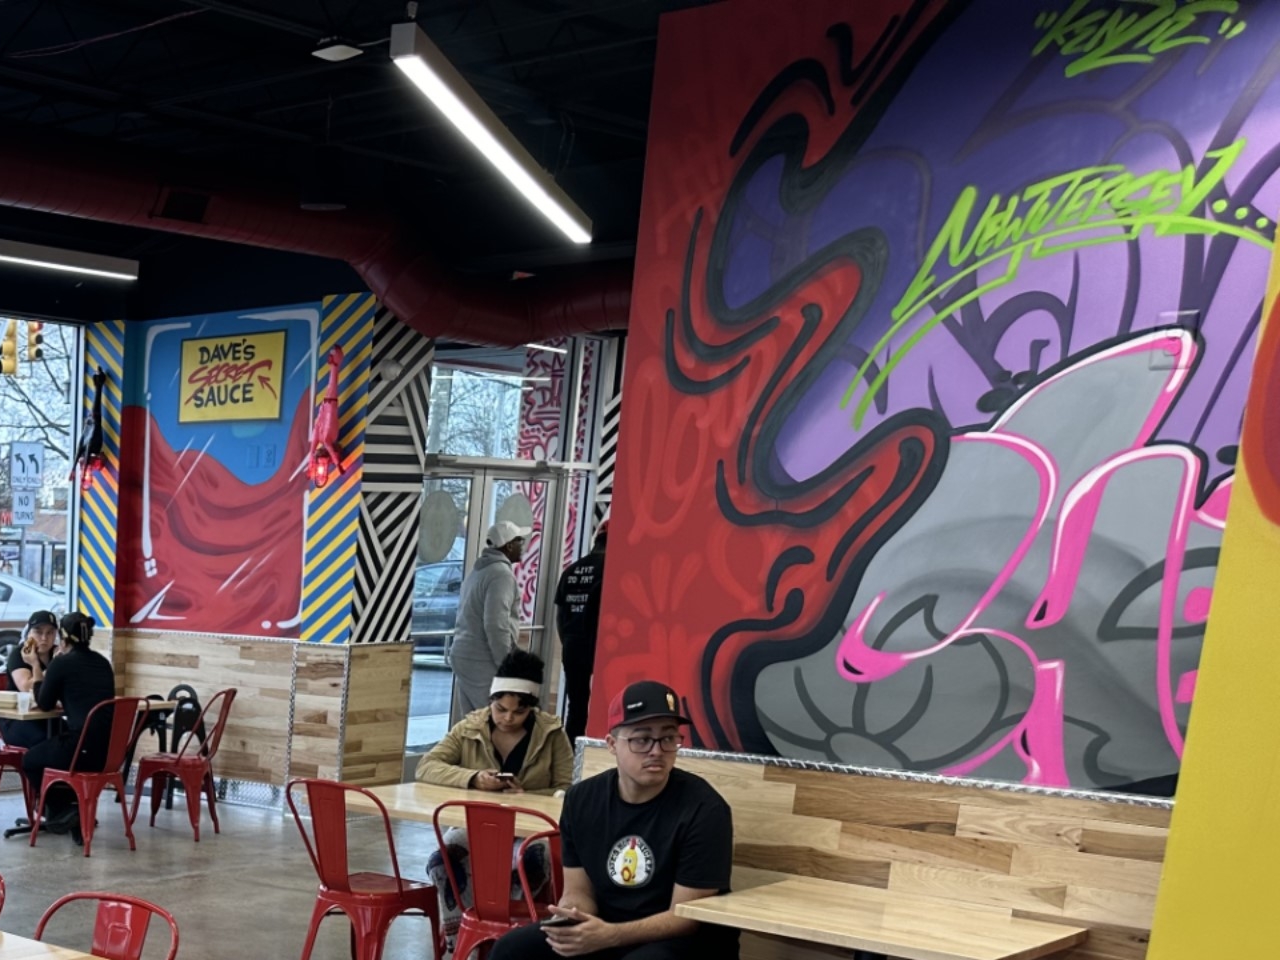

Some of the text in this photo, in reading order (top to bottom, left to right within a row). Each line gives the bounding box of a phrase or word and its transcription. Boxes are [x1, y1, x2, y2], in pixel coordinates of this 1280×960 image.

[199, 338, 256, 365] DAVE'S
[193, 384, 254, 408] SAUCE
[18, 495, 29, 507] NO
[15, 511, 34, 521] TURNS
